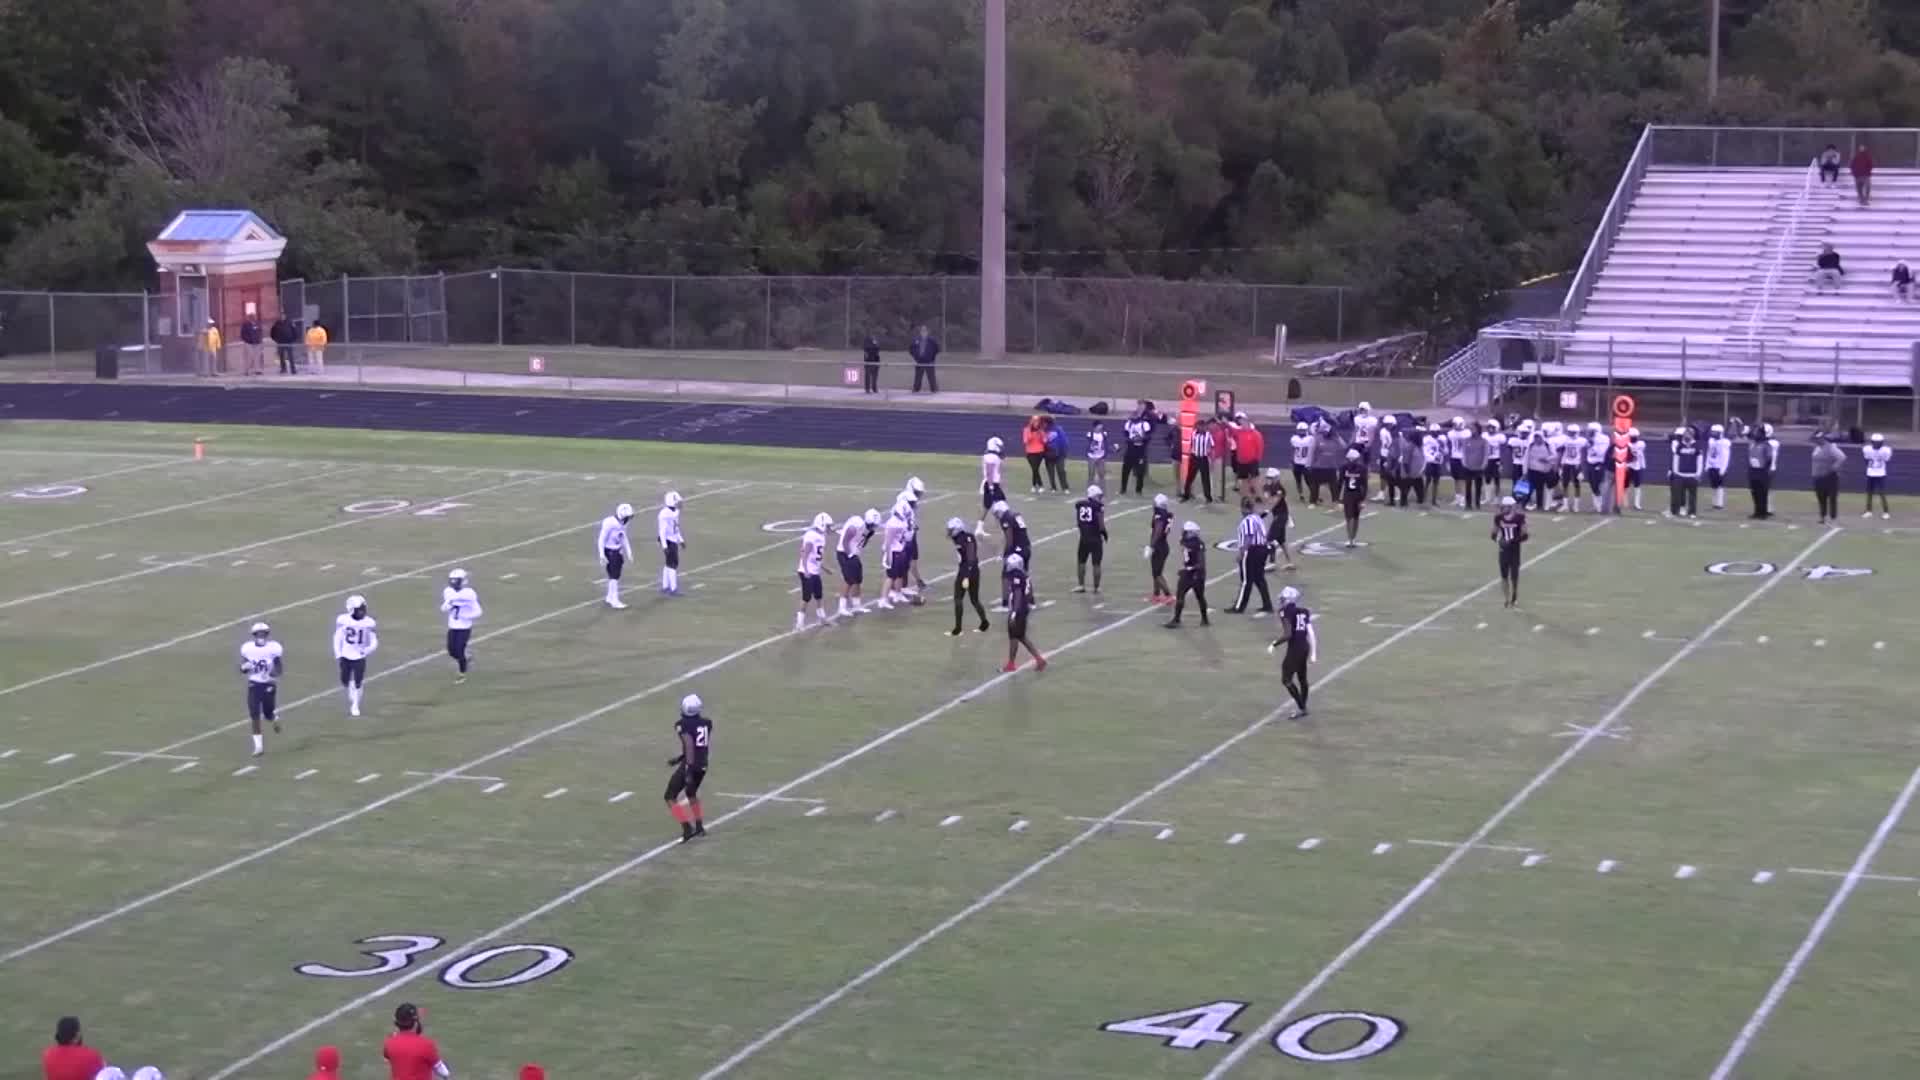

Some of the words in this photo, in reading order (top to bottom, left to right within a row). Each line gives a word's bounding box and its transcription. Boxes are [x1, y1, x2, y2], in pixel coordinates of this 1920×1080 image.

[1079, 506, 1093, 522] 23
[1295, 613, 1306, 630] 15
[345, 626, 363, 645] 21
[695, 726, 708, 747] 21
[298, 936, 574, 989] 30
[1102, 1001, 1402, 1062] 40
